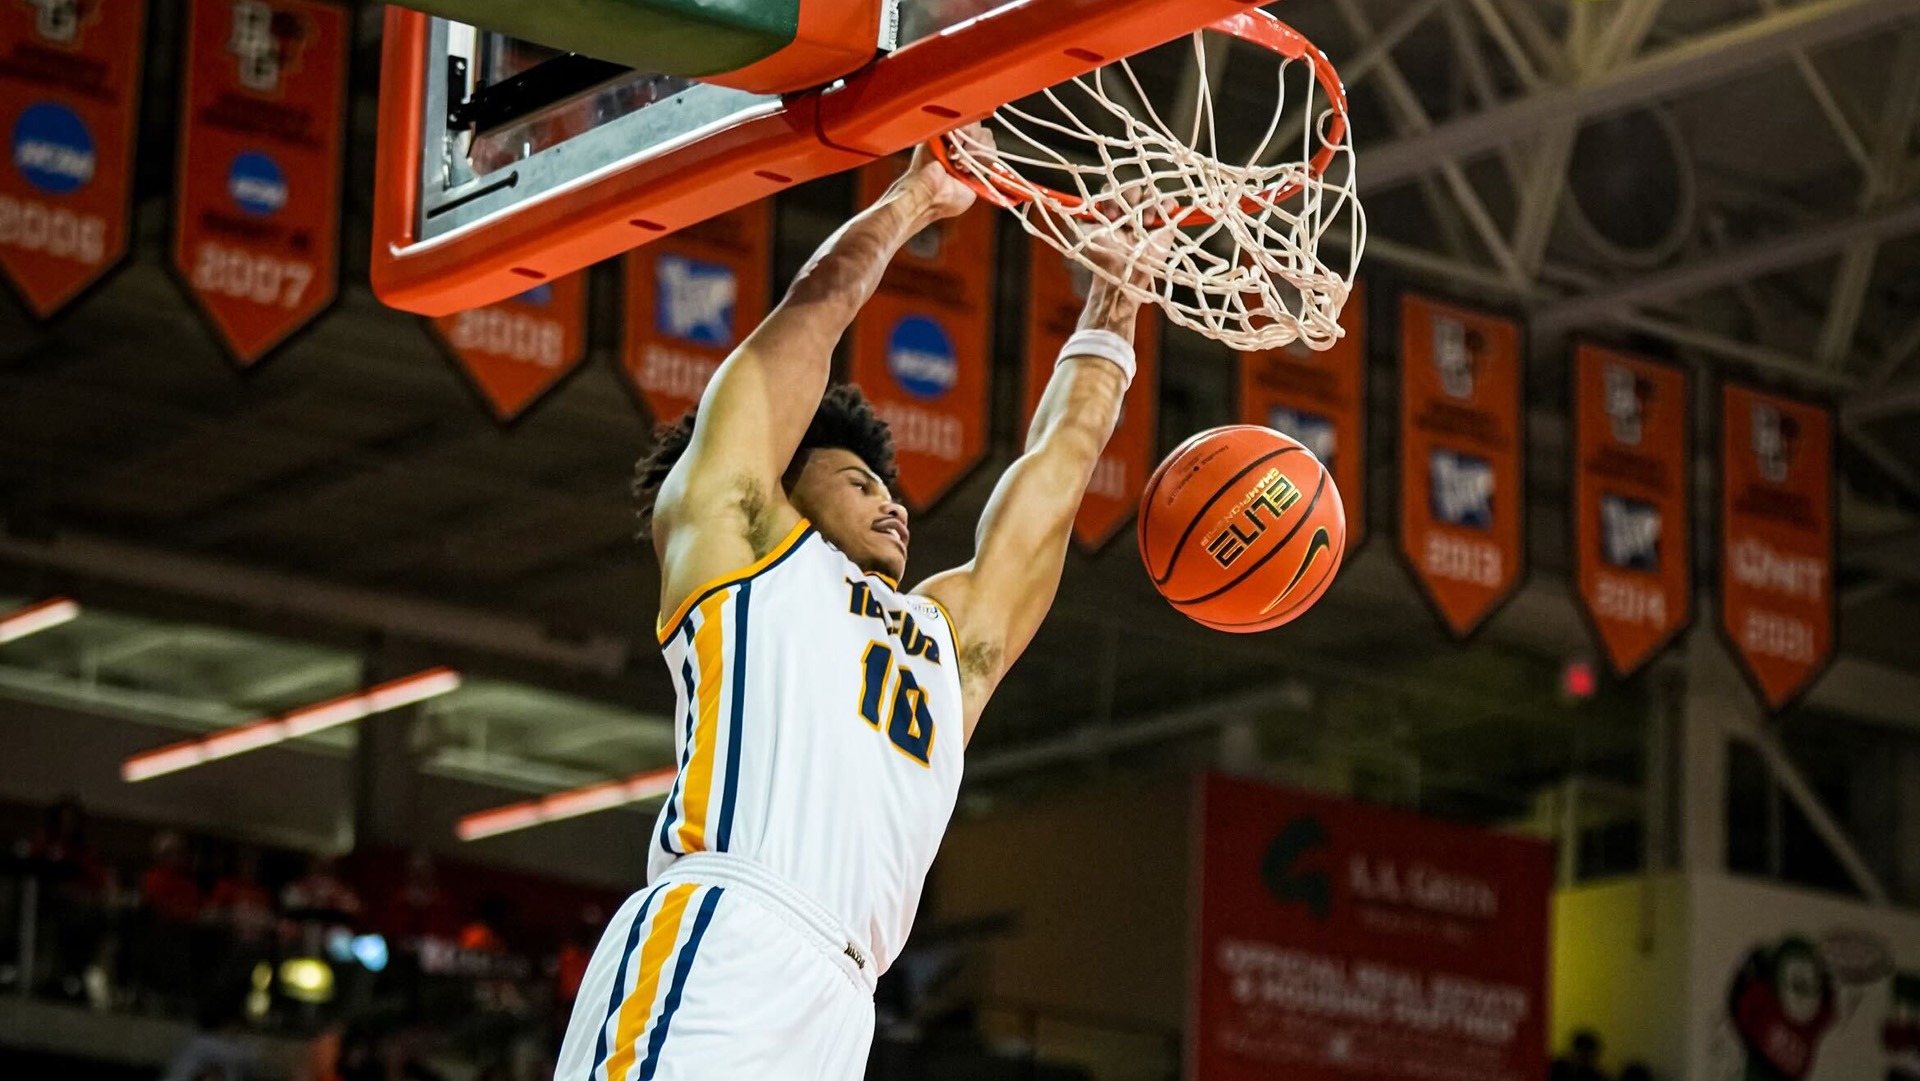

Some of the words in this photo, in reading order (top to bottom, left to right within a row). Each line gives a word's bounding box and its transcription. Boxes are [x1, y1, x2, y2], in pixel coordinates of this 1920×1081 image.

[193, 242, 312, 309] 2007
[637, 343, 699, 400] 200
[1200, 467, 1280, 547] CHAMPIONSHIP
[1205, 474, 1303, 570] ELITE
[1424, 529, 1503, 590] 2013
[845, 576, 941, 666] TOEDO
[1596, 570, 1666, 631] 2014
[858, 639, 936, 768] 10
